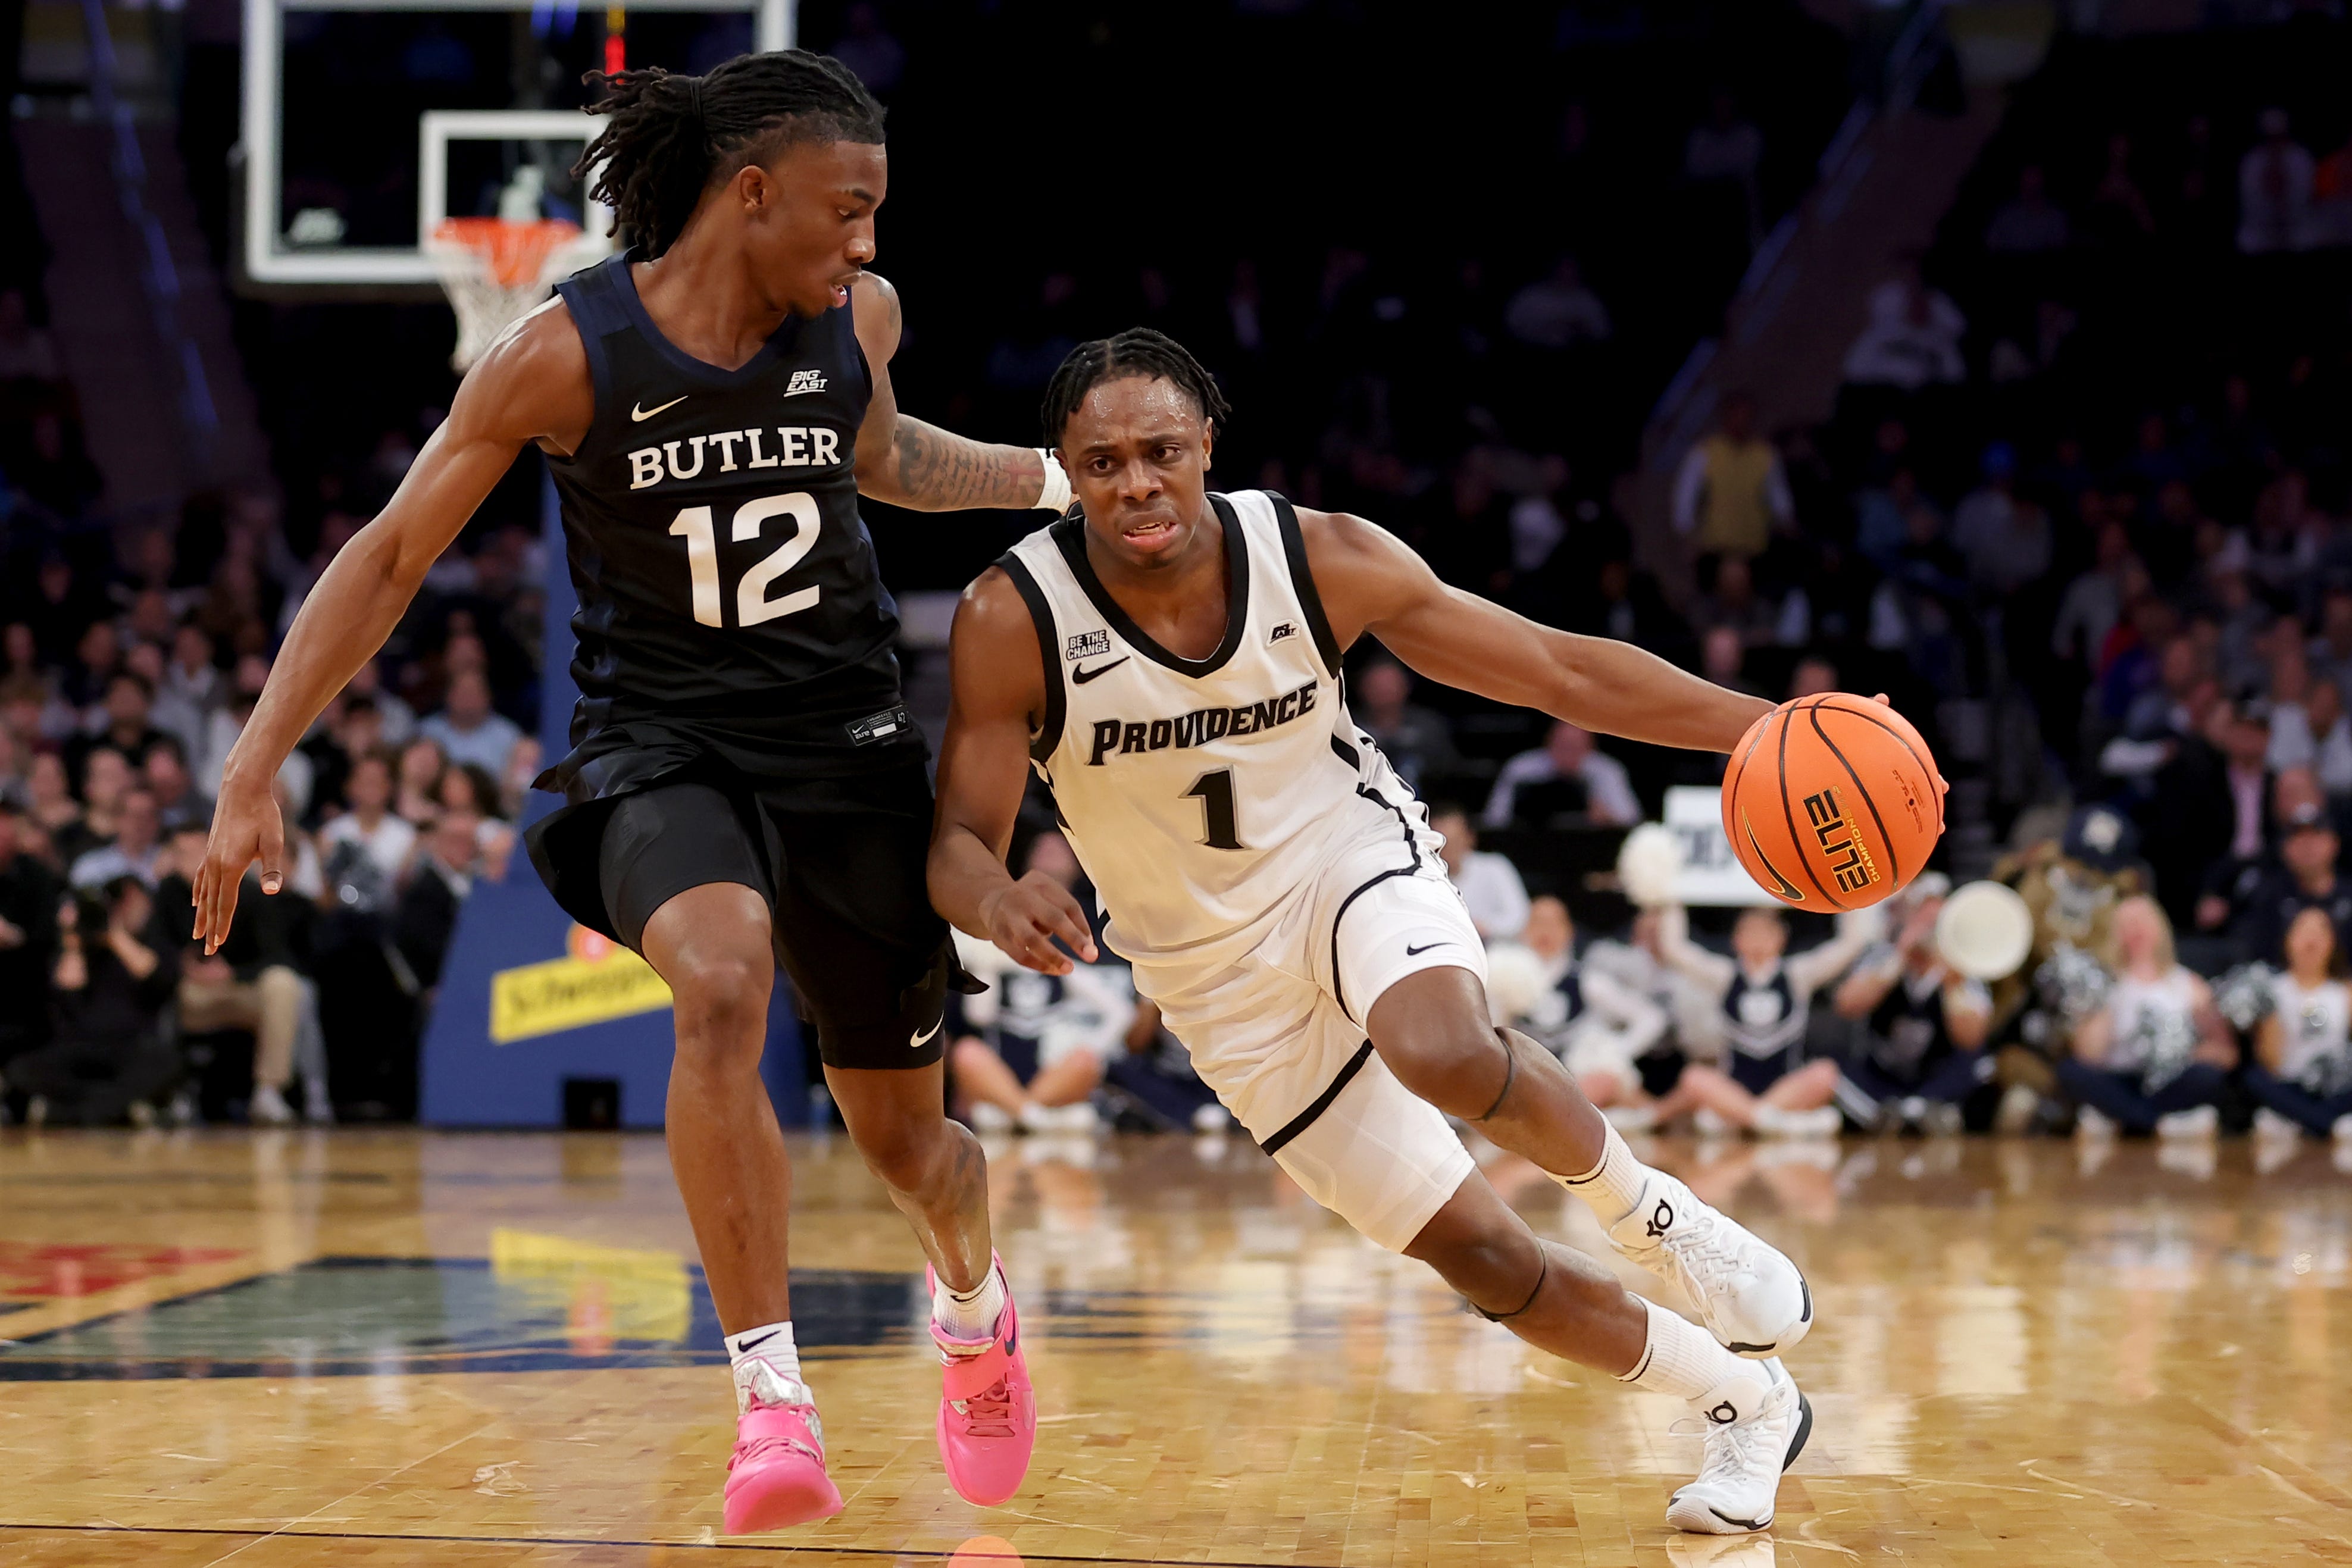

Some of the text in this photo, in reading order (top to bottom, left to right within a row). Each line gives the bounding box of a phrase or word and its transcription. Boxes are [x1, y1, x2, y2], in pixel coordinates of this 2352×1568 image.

[786, 378, 828, 392] EAST
[790, 370, 821, 382] BIG
[627, 427, 841, 490] BUTLER
[669, 492, 821, 628] 12
[1066, 641, 1108, 659] CHANGE
[1069, 631, 1105, 648] BE THE
[897, 712, 906, 723] 42
[1084, 678, 1318, 766] PROVIDENCE
[1178, 763, 1255, 852] 1
[1802, 788, 1872, 894] ELITE
